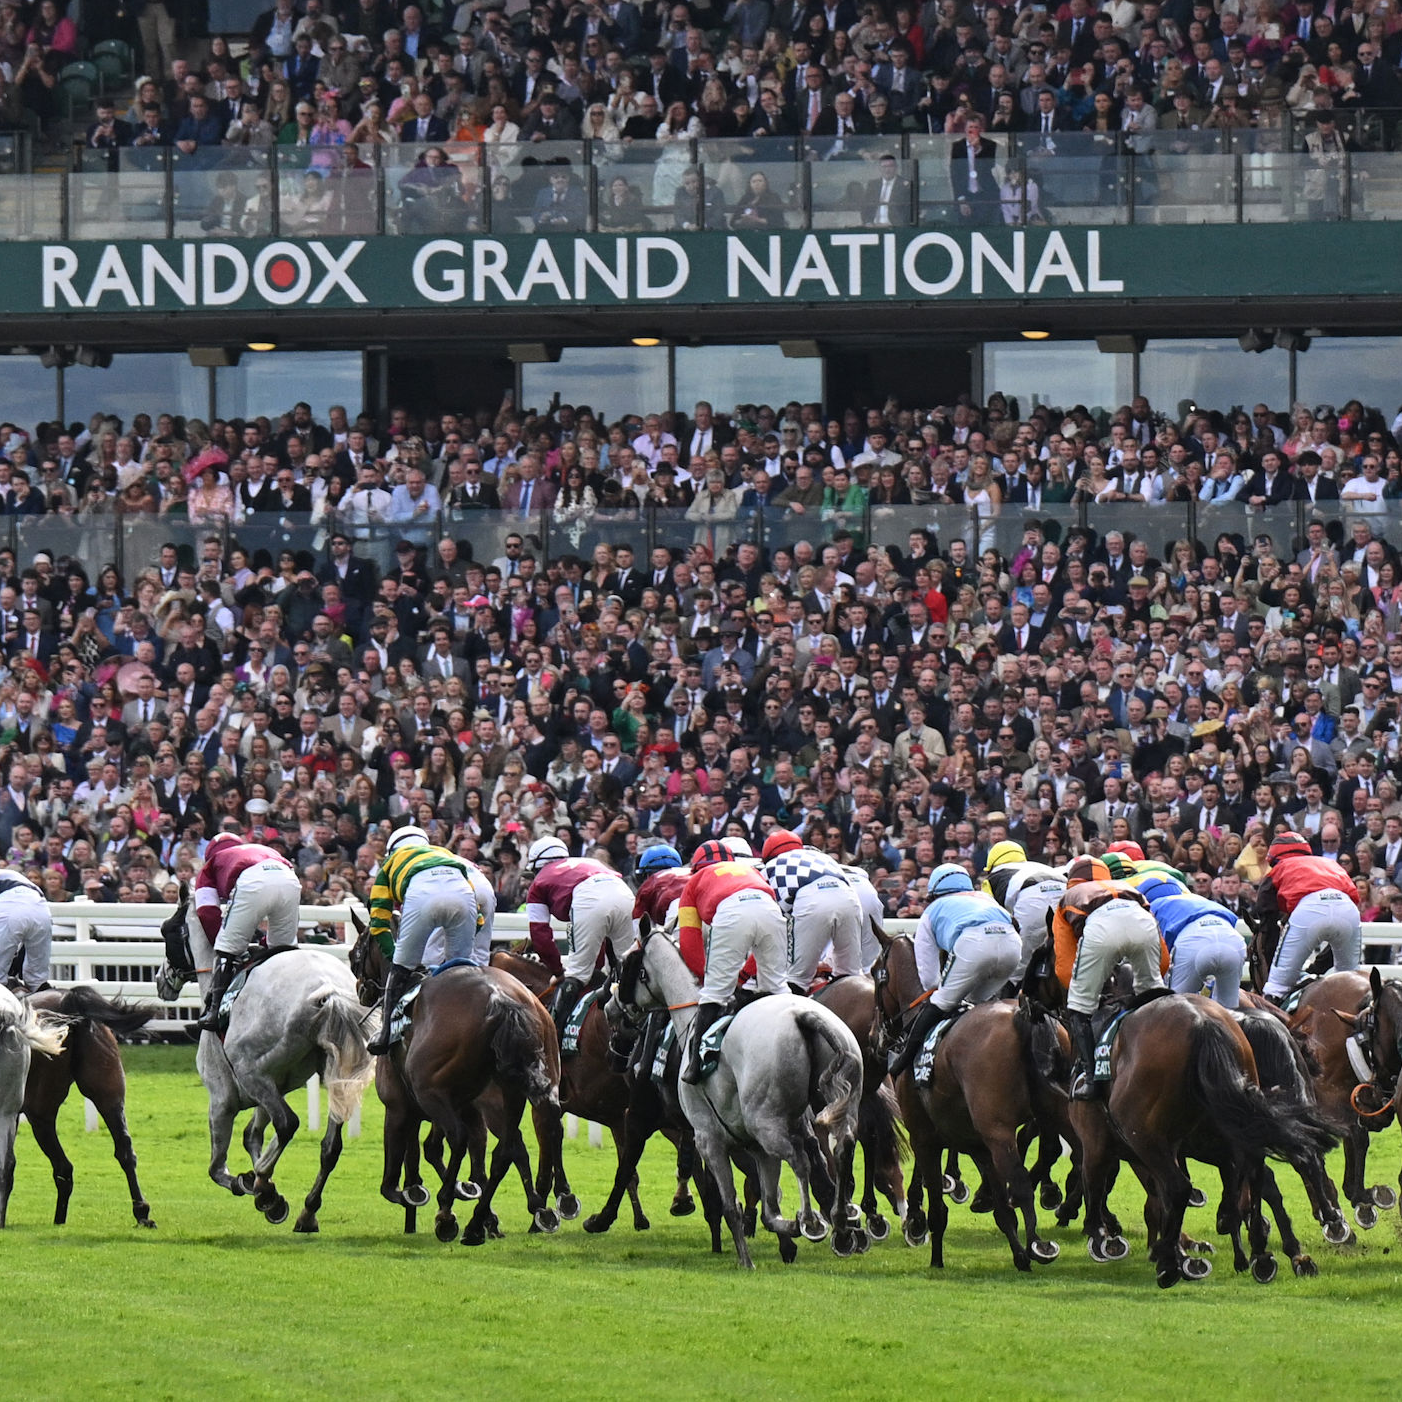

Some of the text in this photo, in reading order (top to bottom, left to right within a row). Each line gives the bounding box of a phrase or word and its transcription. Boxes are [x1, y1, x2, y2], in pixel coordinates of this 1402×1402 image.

[42, 230, 1124, 307] RANDOX GRAND NATIONAL
[878, 969, 887, 979] 12
[1095, 1061, 1111, 1076] EATS
